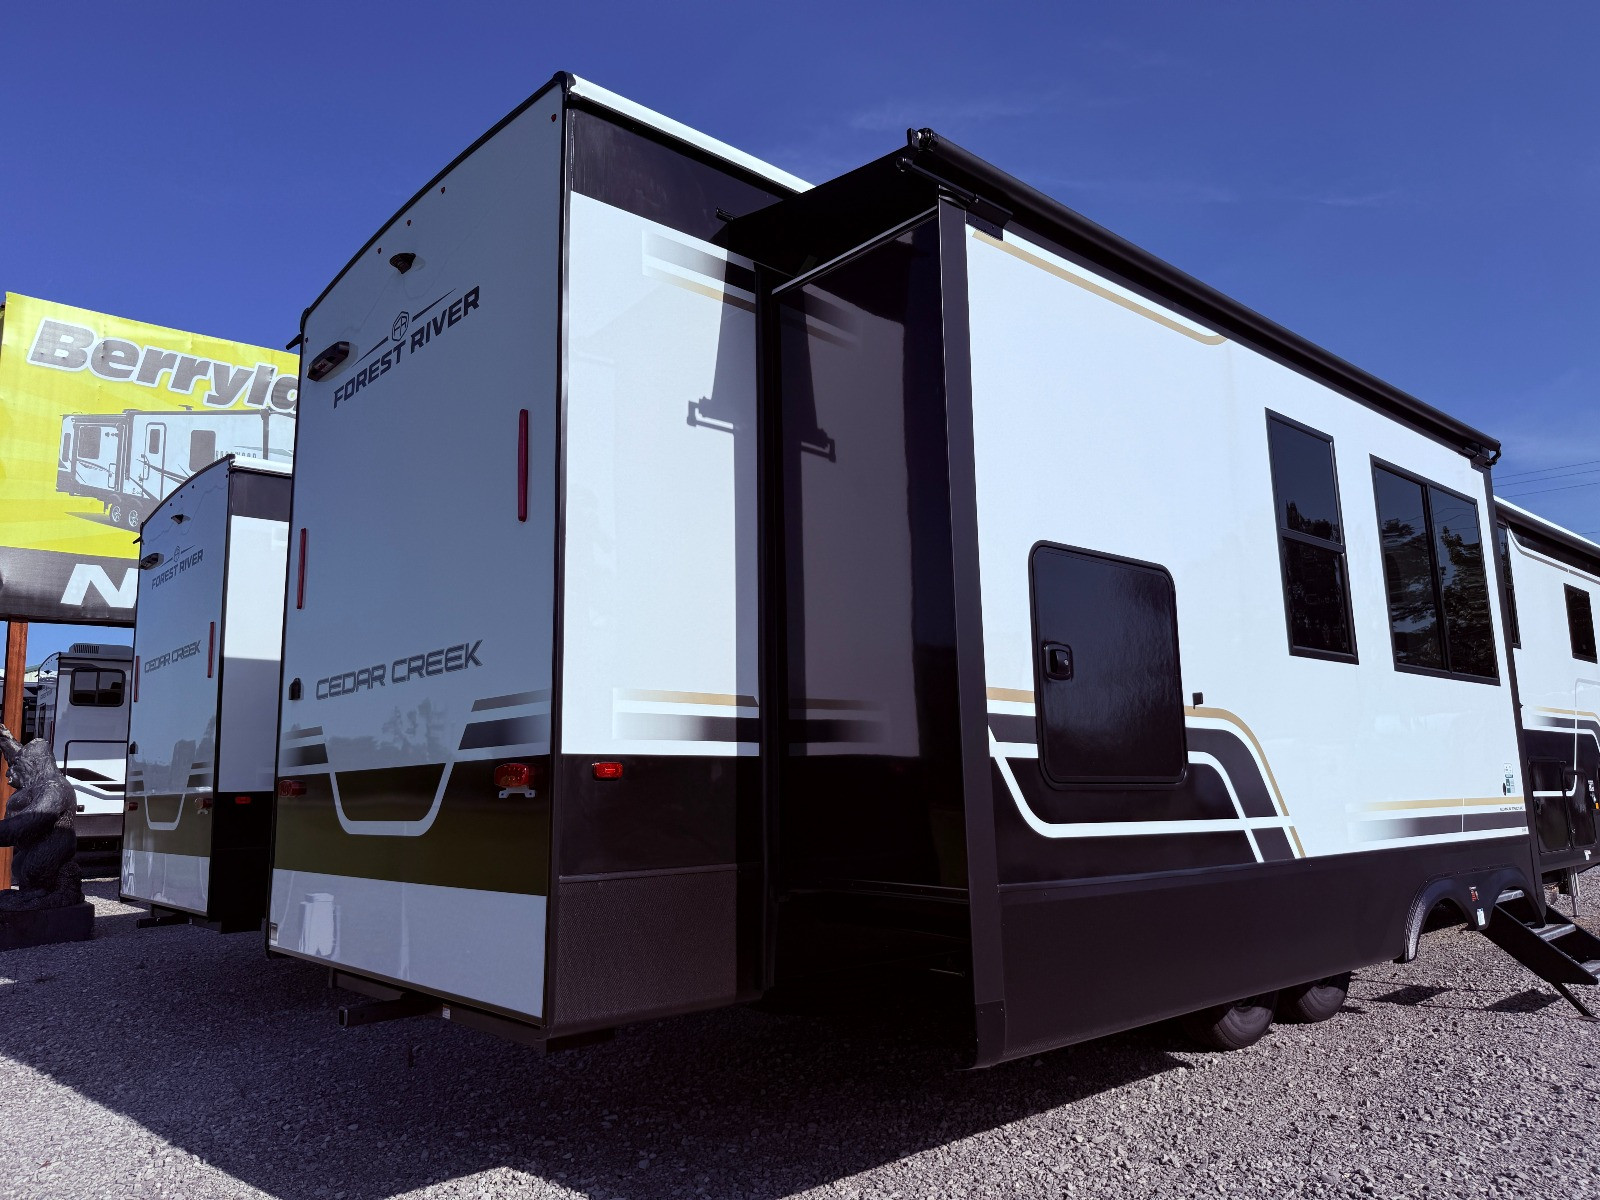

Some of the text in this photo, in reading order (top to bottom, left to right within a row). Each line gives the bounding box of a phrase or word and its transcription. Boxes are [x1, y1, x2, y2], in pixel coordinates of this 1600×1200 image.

[333, 340, 406, 409] FOREST
[410, 285, 480, 355] RIVER
[151, 563, 179, 590] FOREST
[179, 549, 204, 574] RIVER
[144, 639, 202, 674] CEDAR CREEK
[316, 639, 484, 701] CEDAR CREEK
